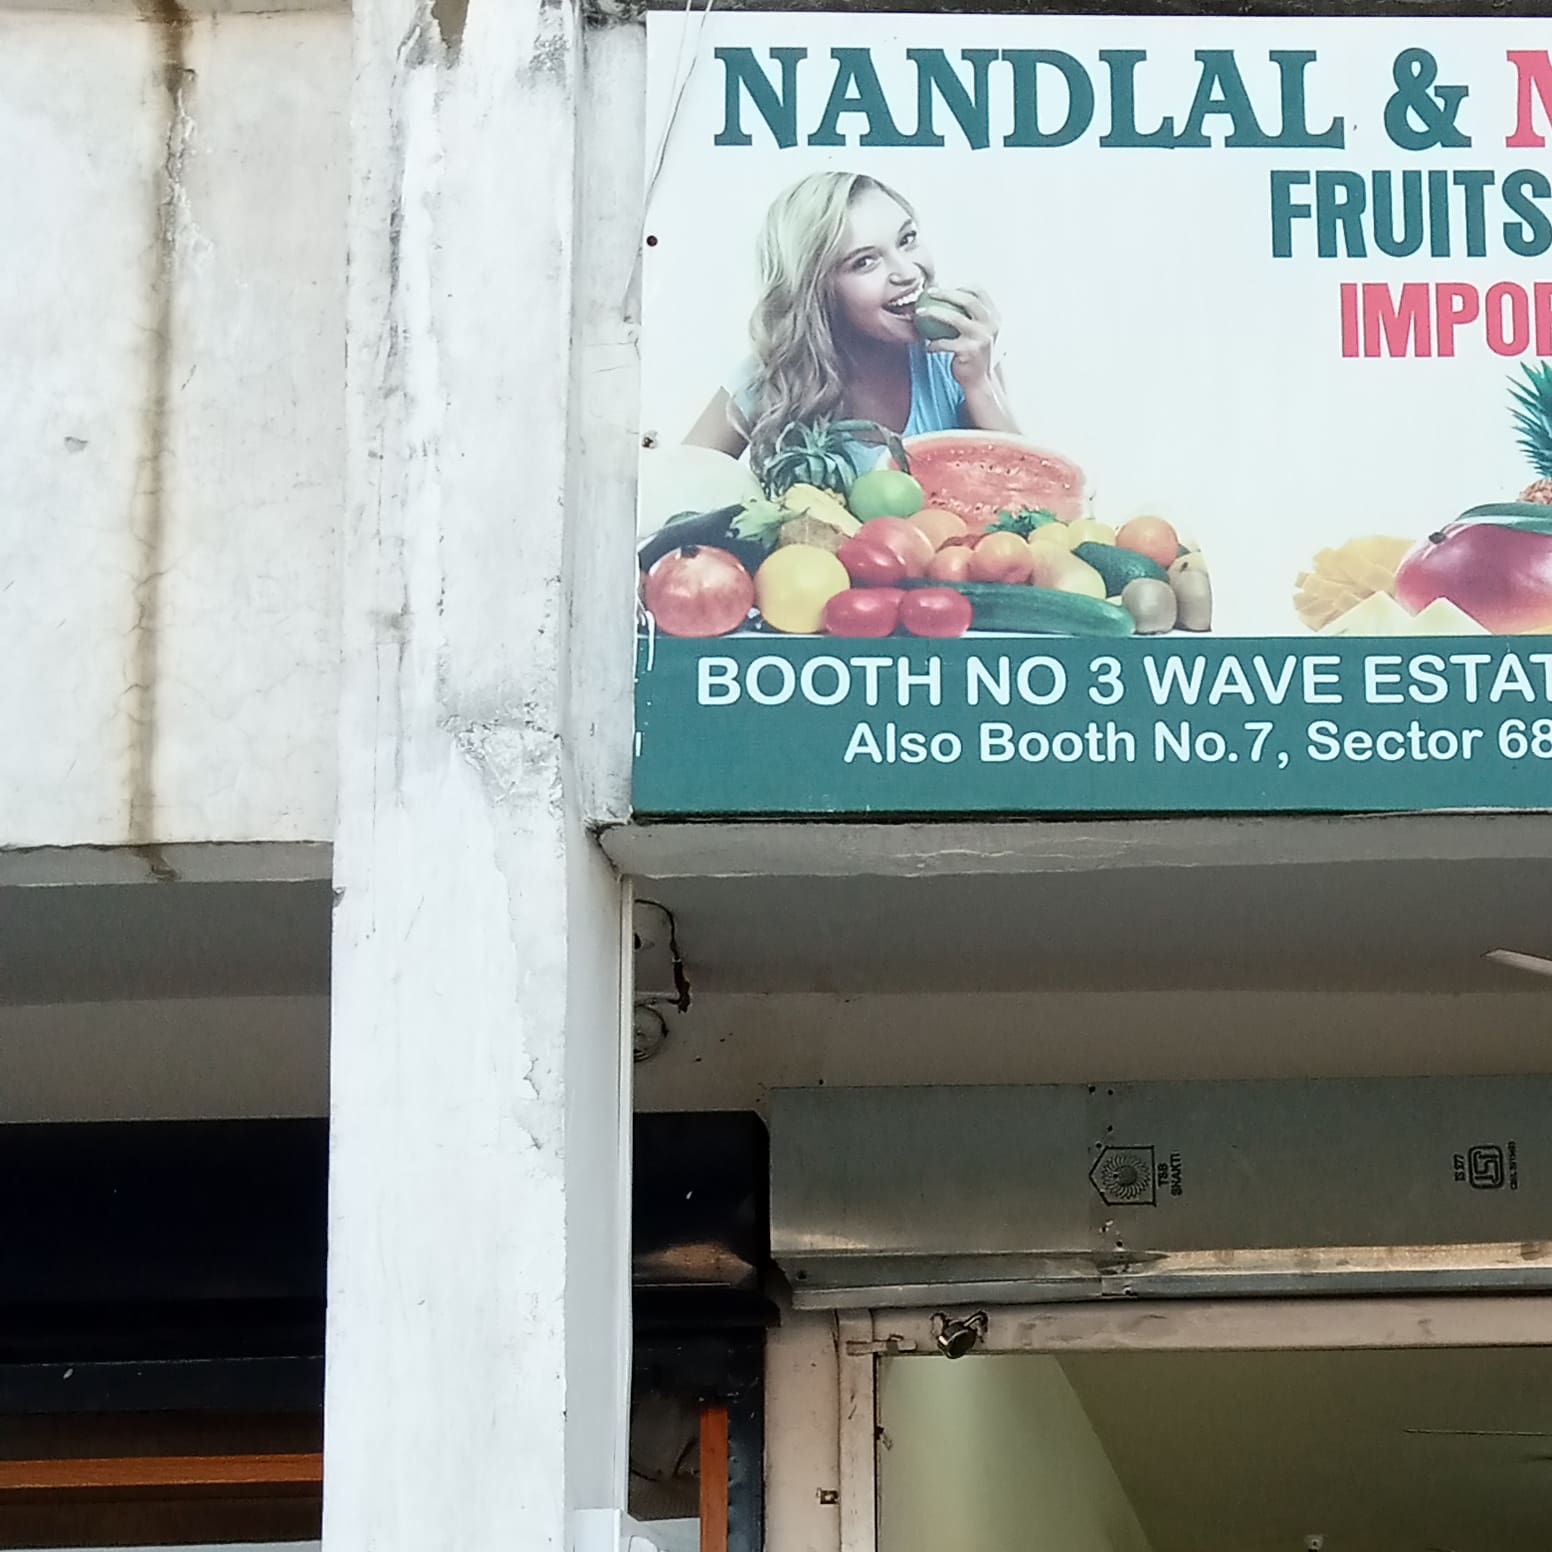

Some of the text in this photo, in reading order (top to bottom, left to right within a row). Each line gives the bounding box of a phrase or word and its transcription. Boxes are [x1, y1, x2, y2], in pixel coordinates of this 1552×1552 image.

[714, 47, 1345, 149] NANDLAL
[1385, 49, 1474, 151] &
[1272, 171, 1552, 258] FRUITS
[697, 655, 941, 706] BOOTH
[967, 656, 1066, 705] NO
[1089, 656, 1124, 705] 3
[1144, 655, 1343, 705] WAVE
[844, 721, 962, 763] Also
[979, 721, 1135, 762] Booth
[1154, 720, 1289, 769] No.7,
[1307, 719, 1484, 761] Sector
